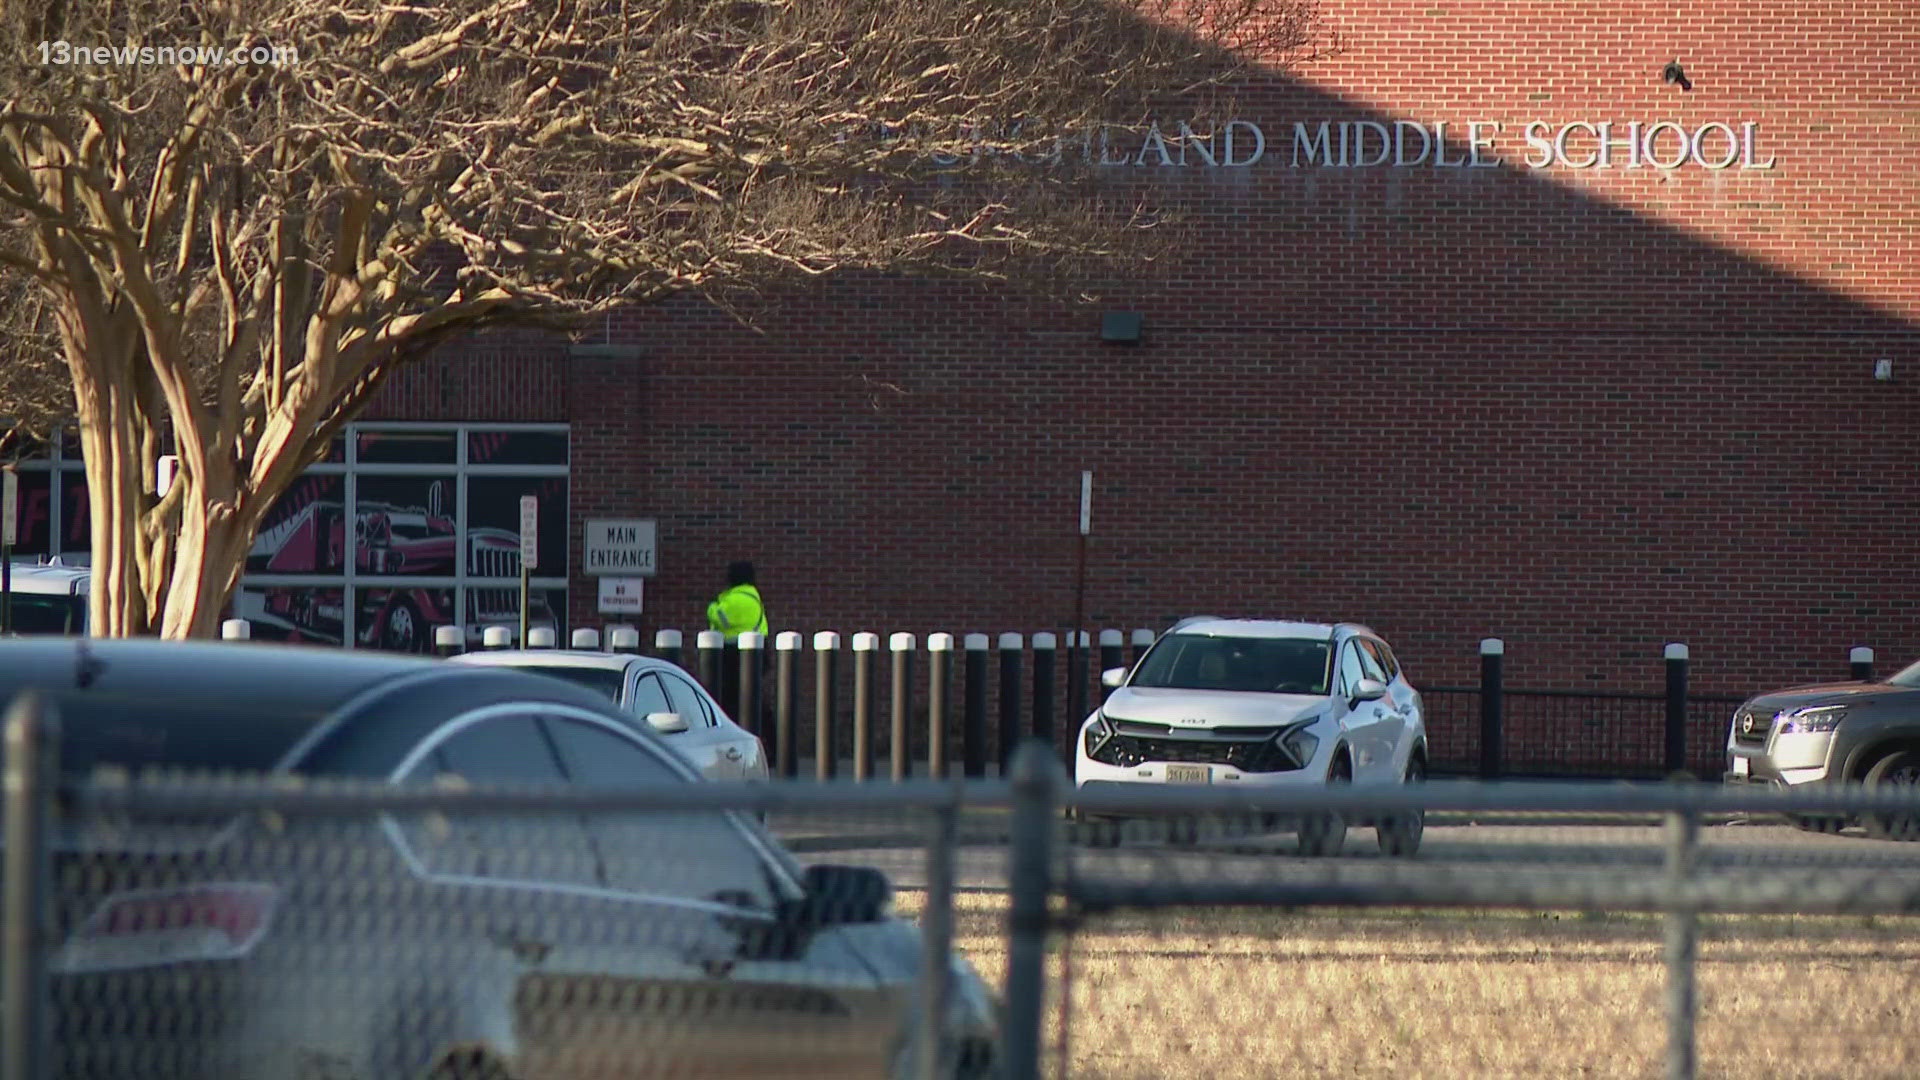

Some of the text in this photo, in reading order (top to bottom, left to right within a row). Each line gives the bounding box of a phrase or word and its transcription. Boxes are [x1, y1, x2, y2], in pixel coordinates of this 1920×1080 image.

[1291, 120, 1503, 168] MIDDLE
[1524, 121, 1776, 170] SCHOOL
[607, 527, 636, 544] MAIN
[590, 549, 652, 568] ENTRANCE
